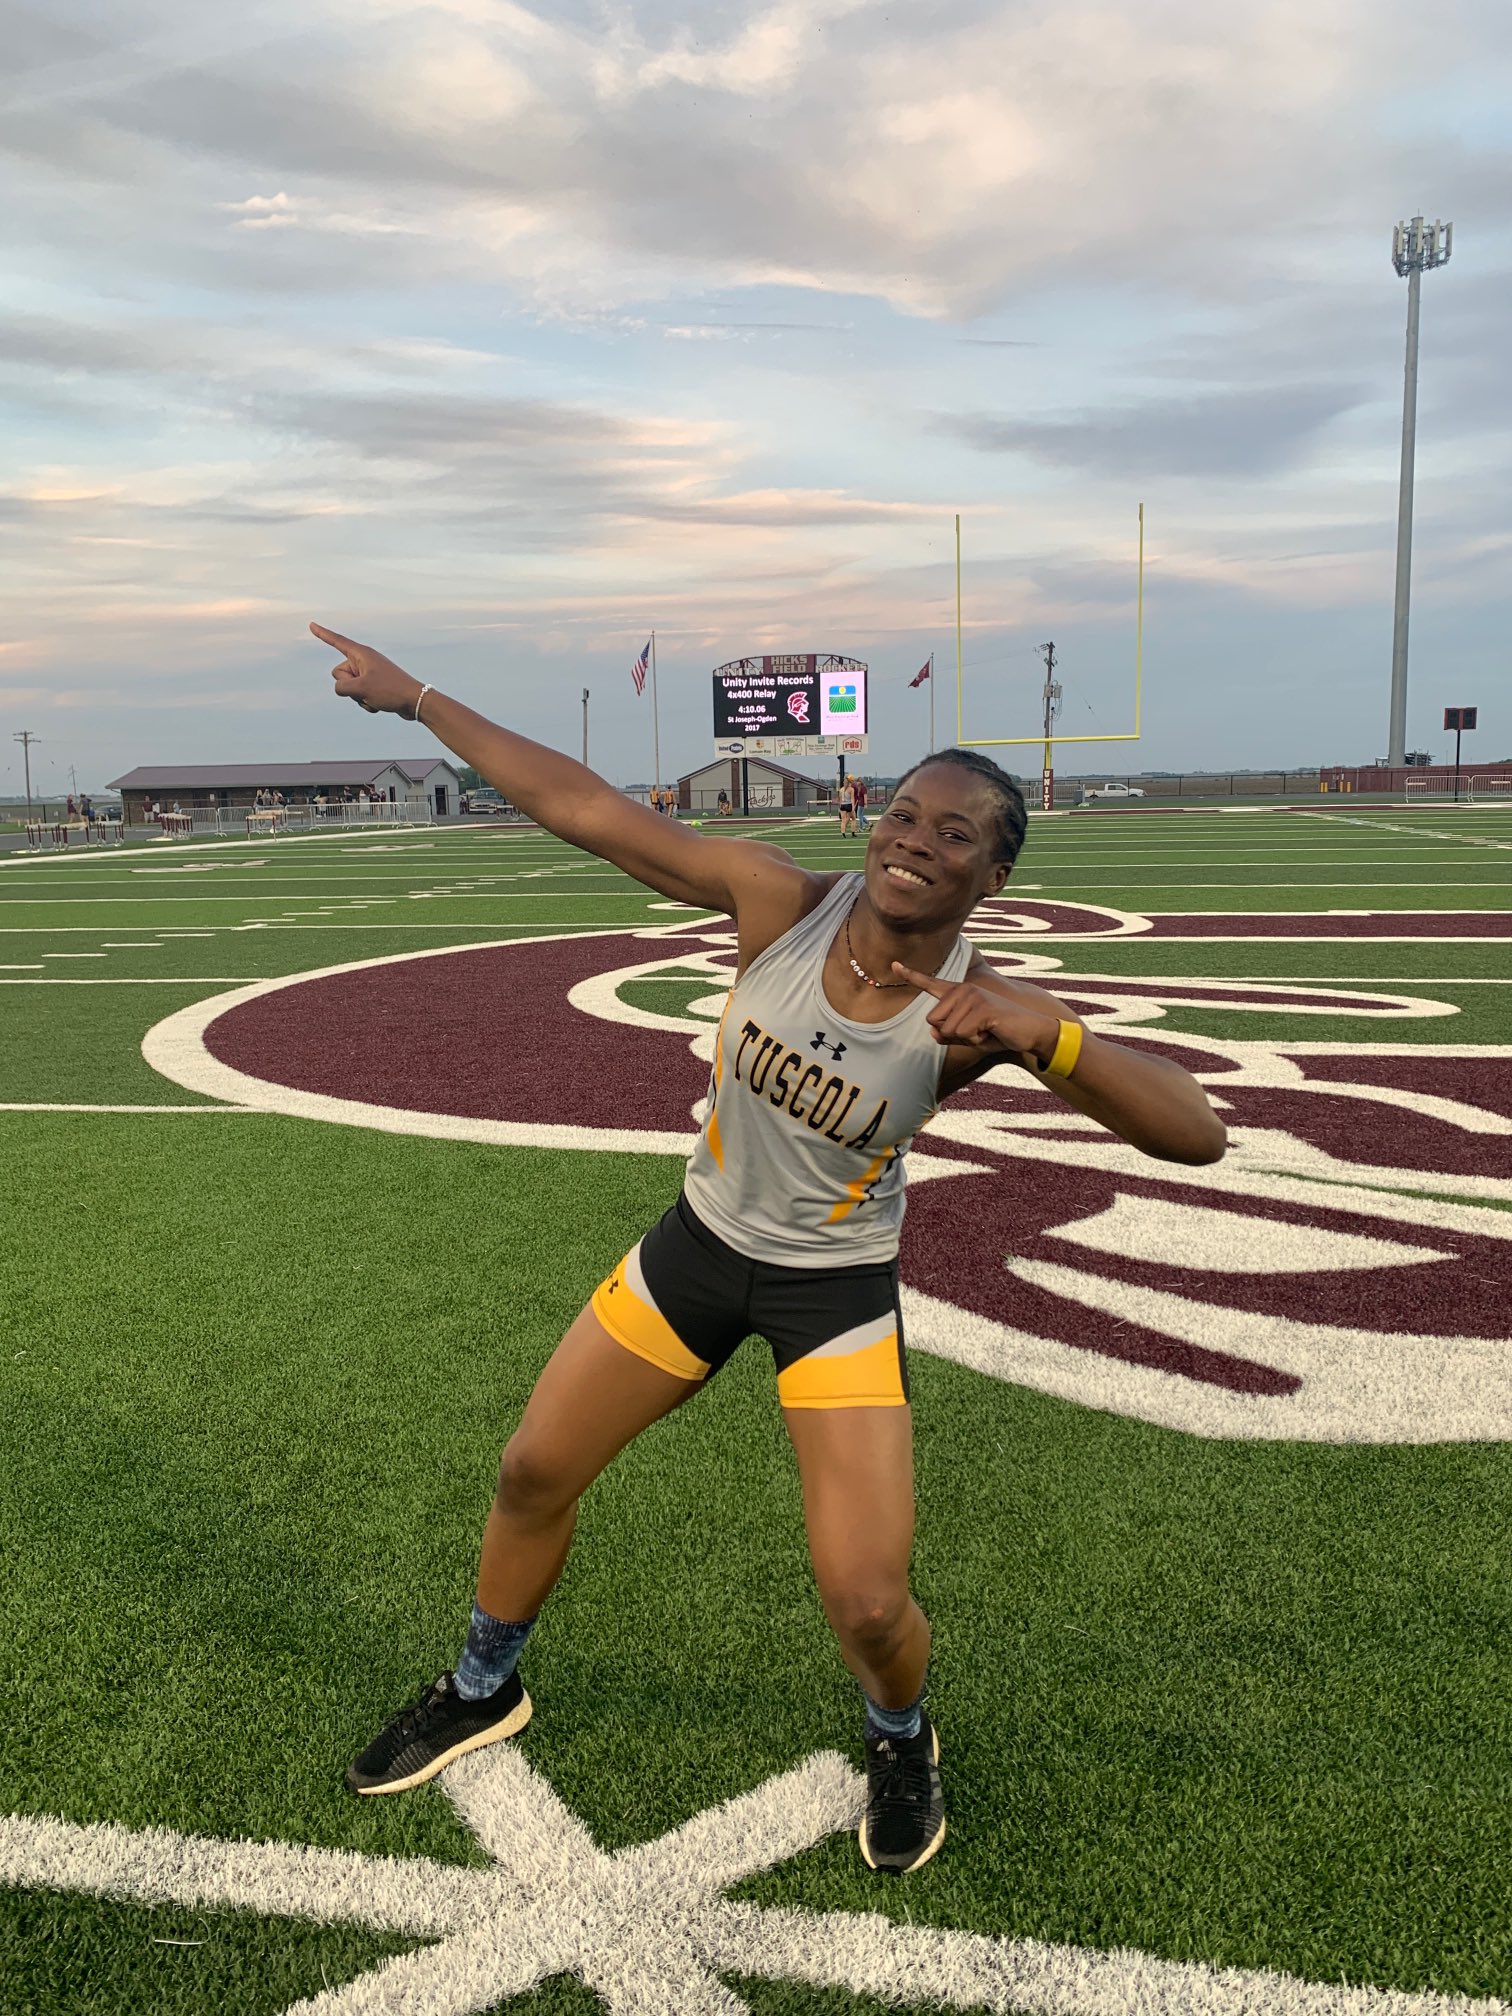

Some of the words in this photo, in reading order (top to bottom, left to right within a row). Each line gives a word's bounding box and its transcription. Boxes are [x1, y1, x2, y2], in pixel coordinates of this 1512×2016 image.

[771, 655, 808, 665] HICKS
[715, 667, 764, 677] UNITY
[772, 664, 807, 674] FIELD
[815, 663, 867, 673] ROCKETS
[722, 678, 747, 688] Unity
[749, 676, 775, 686] Invite
[777, 675, 814, 686] Records
[727, 690, 752, 699] 4x400
[753, 689, 777, 700] Relay
[738, 705, 766, 714] 4:10.06
[735, 715, 777, 724] Joseph-Ogden
[744, 724, 761, 732] 2017
[844, 740, 860, 749] rds
[734, 1019, 888, 1150] TUSCOLA
